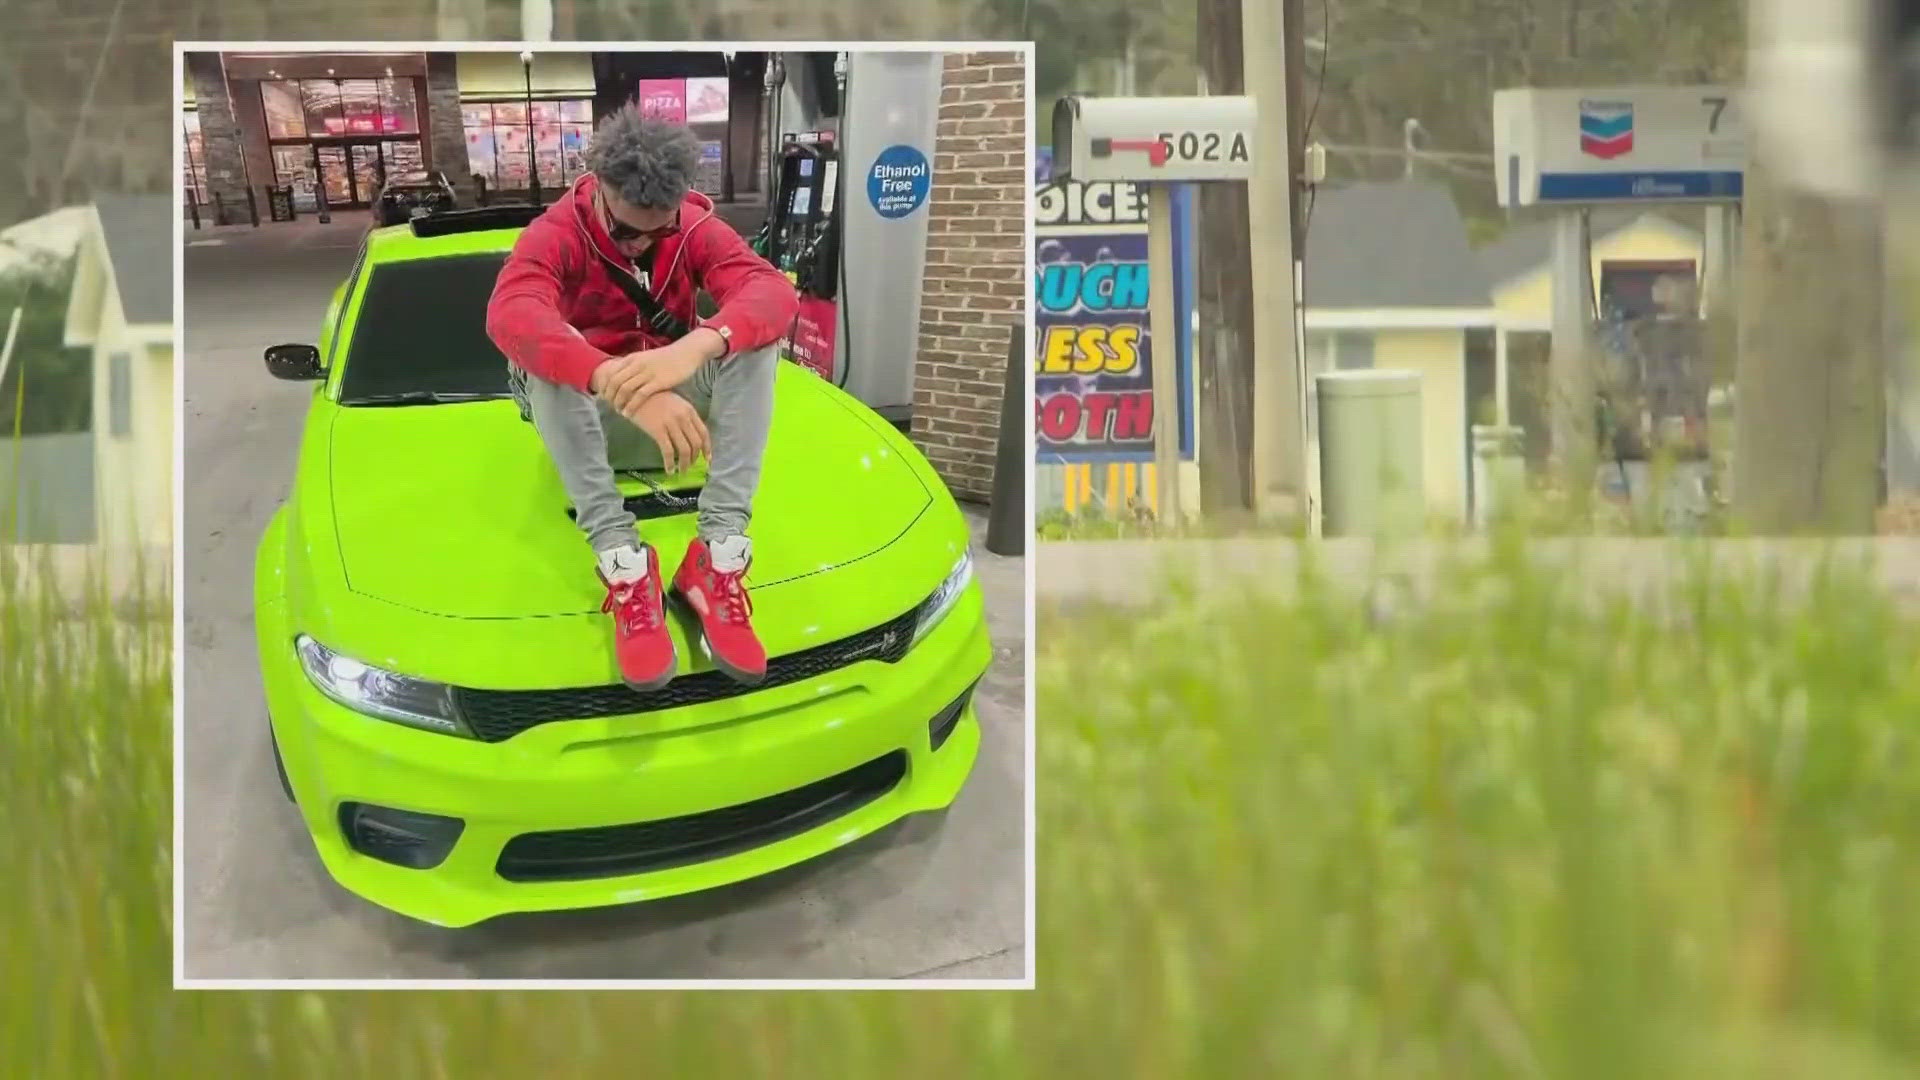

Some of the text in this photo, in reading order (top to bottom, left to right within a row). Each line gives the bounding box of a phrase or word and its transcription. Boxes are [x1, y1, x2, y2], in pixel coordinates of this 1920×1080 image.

[644, 97, 681, 109] PIZZA
[875, 163, 925, 178] Ethanol
[882, 179, 912, 192] Free
[1035, 265, 1150, 312] UCH
[1035, 326, 1139, 375] ESS
[1035, 392, 1154, 441] OTH
